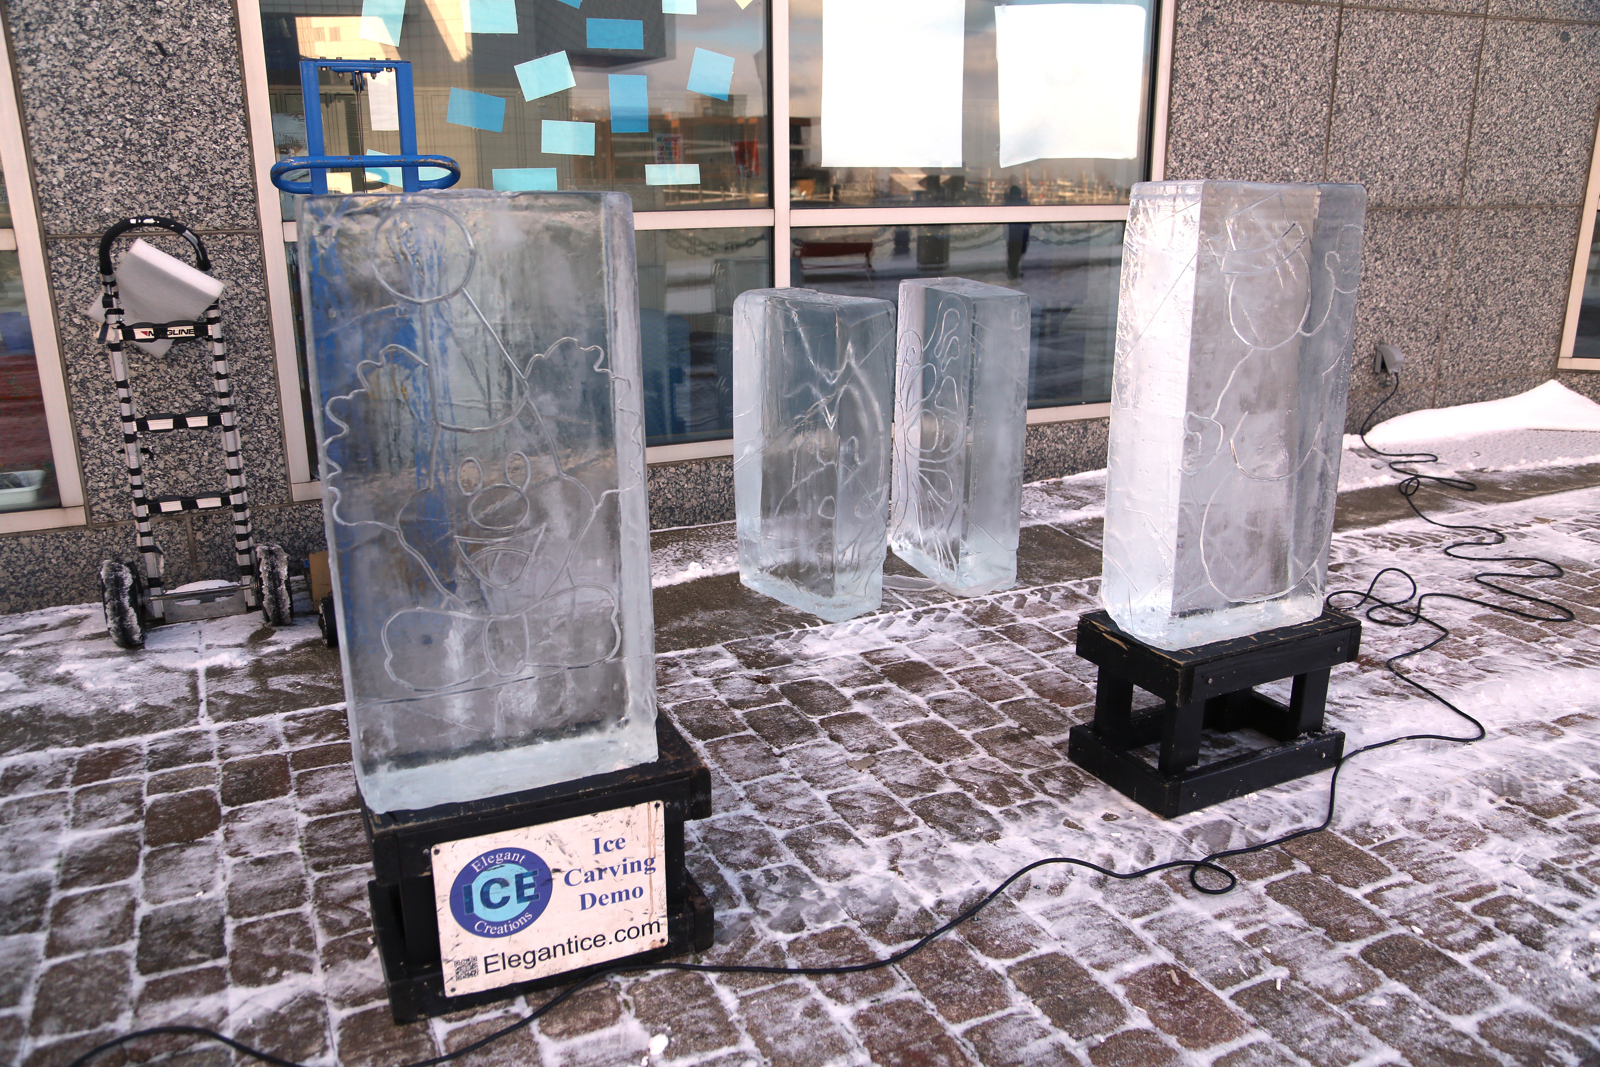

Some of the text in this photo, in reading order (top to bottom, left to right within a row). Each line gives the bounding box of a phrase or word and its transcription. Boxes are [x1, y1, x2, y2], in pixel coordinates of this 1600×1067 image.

[591, 837, 626, 855] Ice
[471, 851, 526, 873] Elegant
[563, 857, 656, 887] Carving
[462, 869, 540, 915] ICE
[578, 885, 644, 911] Demo
[473, 911, 533, 935] Creations
[483, 920, 661, 974] Elegantice.com
